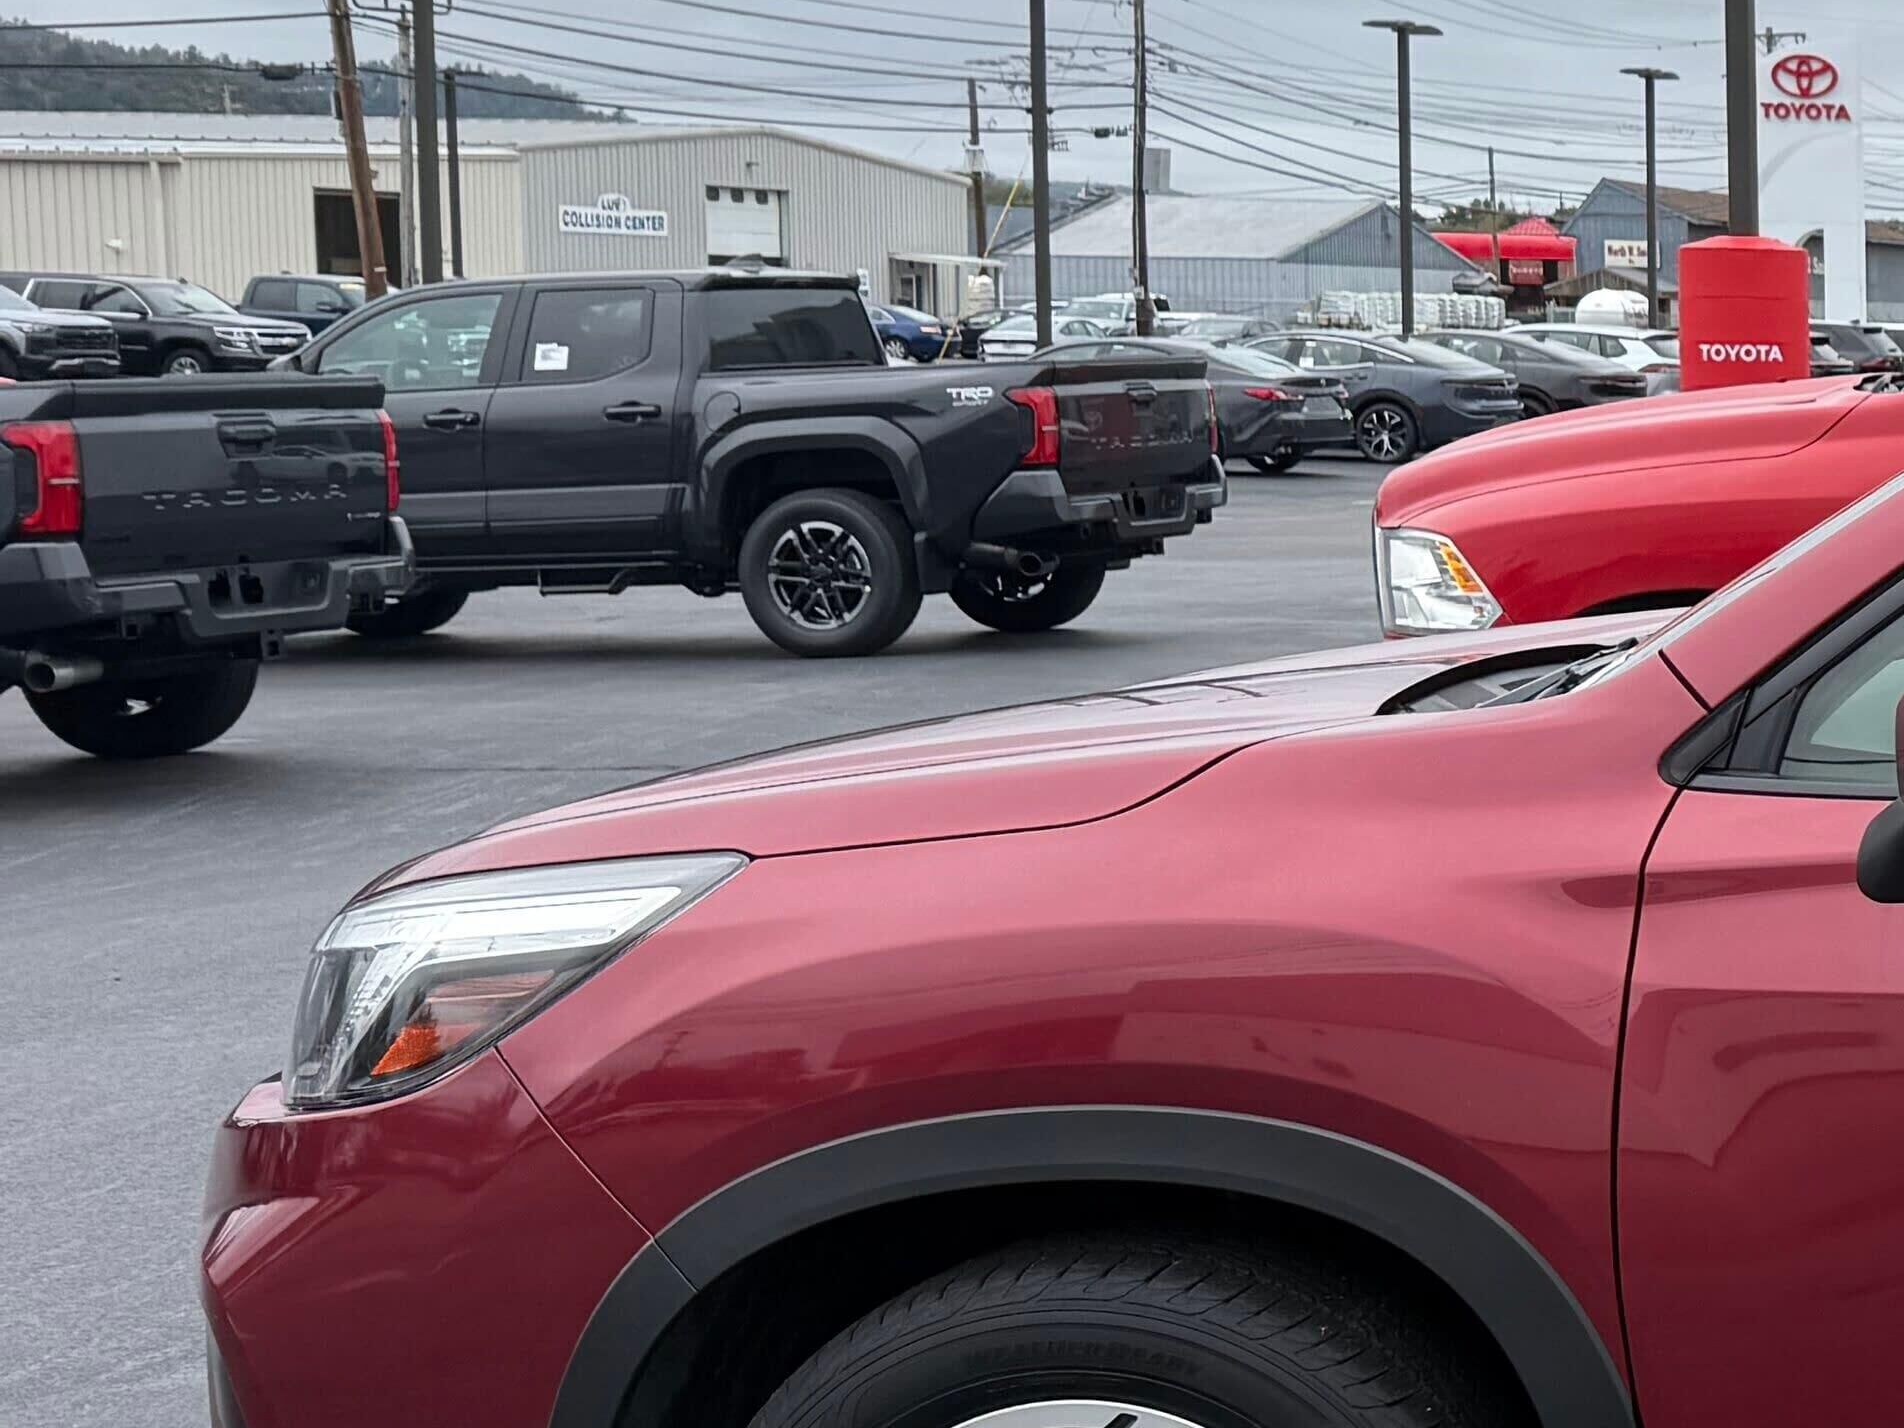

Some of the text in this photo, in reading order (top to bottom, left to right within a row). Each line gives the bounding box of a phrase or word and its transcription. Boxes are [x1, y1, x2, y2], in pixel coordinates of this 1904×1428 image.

[1760, 102, 1851, 122] TOYOTA
[562, 209, 665, 232] COLLISION CENTER
[1698, 342, 1784, 363] TOYOTA
[142, 483, 348, 511] TACOMA
